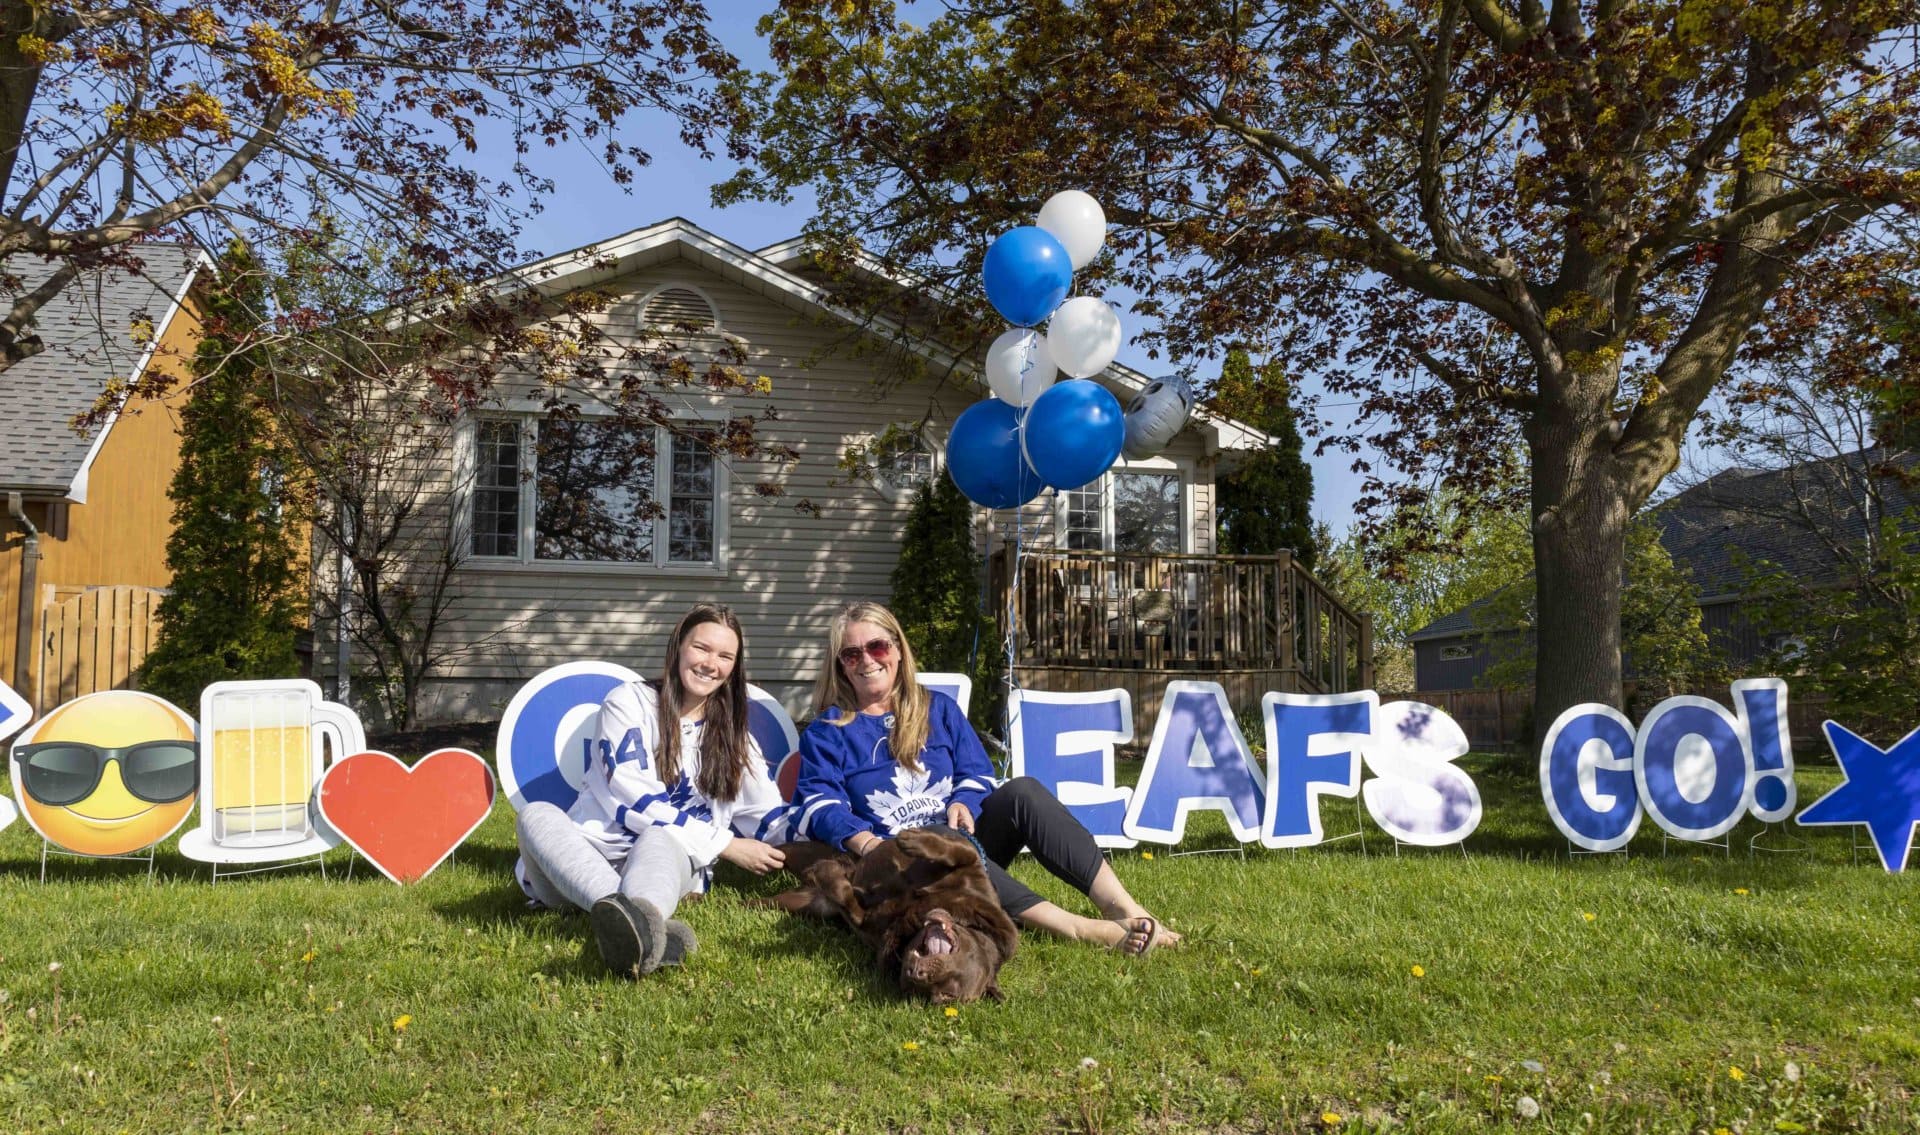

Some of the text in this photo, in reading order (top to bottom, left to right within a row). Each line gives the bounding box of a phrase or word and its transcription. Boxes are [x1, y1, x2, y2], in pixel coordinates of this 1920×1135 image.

[1280, 569, 1290, 633] 1432
[918, 673, 1482, 848] EAFS
[1541, 679, 1796, 850] GO!
[889, 797, 941, 822] TORONTO
